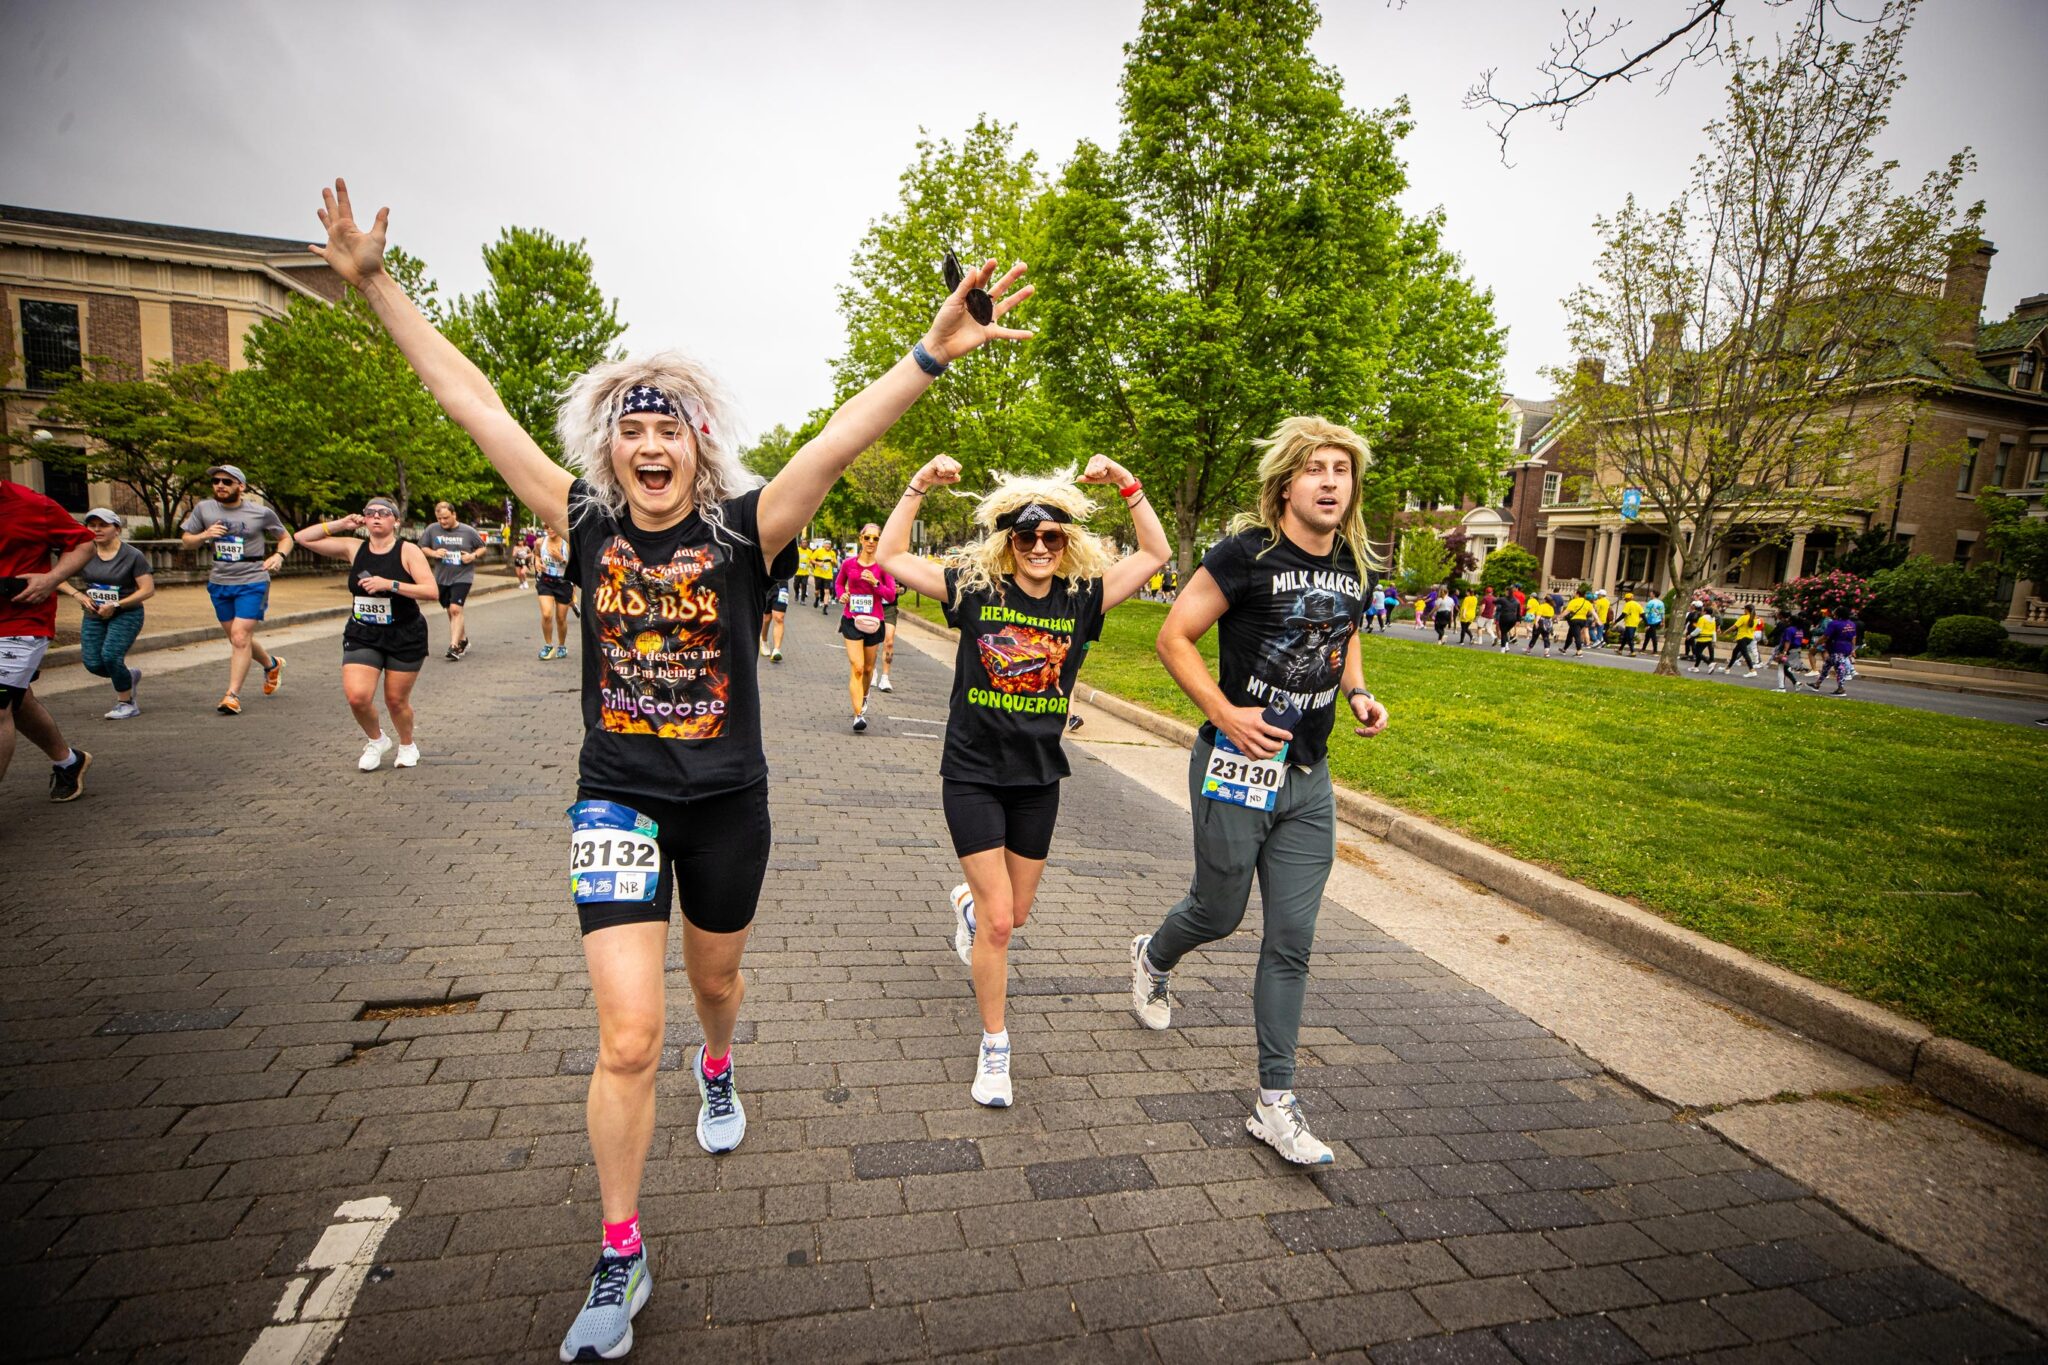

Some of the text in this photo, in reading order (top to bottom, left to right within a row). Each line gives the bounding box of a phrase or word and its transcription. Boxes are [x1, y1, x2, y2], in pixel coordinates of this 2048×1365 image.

[217, 545, 242, 553] 15487
[613, 554, 640, 572] when
[704, 560, 714, 569] a
[1272, 570, 1361, 601] MILK MAKES
[359, 603, 386, 614] 9383
[596, 585, 718, 623] BAD BOY
[646, 649, 698, 661] deserve
[702, 649, 721, 660] me
[658, 666, 696, 680] being
[699, 666, 708, 677] a
[601, 687, 725, 718] Silly Goose
[967, 687, 1069, 714] CONQUEROR
[1246, 675, 1269, 699] MY
[1268, 687, 1313, 710] TMMY
[1210, 757, 1278, 787] 23130
[572, 839, 655, 870] 23132
[595, 879, 613, 893] 25
[619, 881, 639, 894] NB
